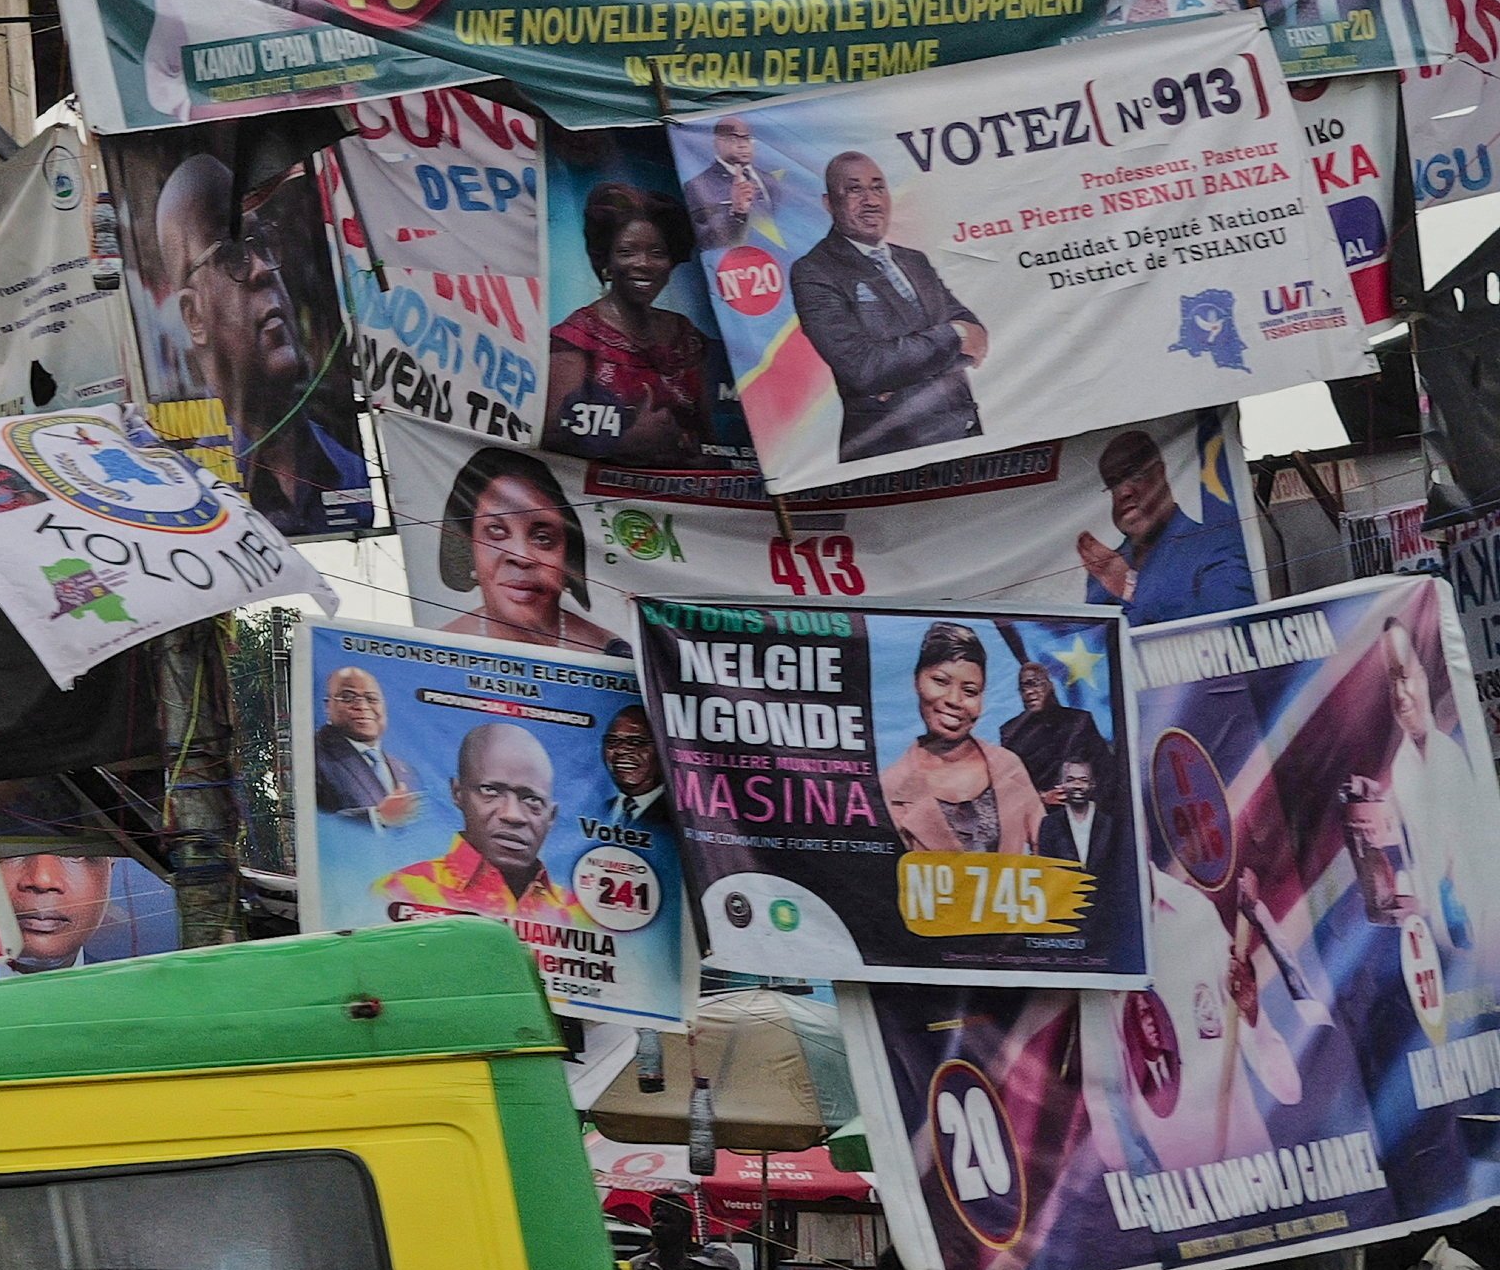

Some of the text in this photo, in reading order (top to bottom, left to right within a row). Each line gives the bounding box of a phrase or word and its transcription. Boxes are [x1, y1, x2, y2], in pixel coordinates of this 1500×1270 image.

[455, 9, 513, 46] UNE
[521, 1, 667, 45] NOUVELLE
[675, 0, 749, 41] PAGE
[764, 40, 939, 86] DE LA FEMME
[897, 100, 1090, 172] VOTEZ
[1082, 141, 1279, 191] Professeur, Pasteur
[952, 162, 1291, 244] Jean Pierre NSENJI BANZA
[1017, 198, 1306, 271] Candidat Député National
[1048, 228, 1288, 291] District de TSHANGU
[570, 403, 622, 437] 374
[34, 511, 214, 591] KOLO
[769, 536, 866, 596] 413
[770, 611, 852, 638] TOUS
[342, 636, 526, 677] SURCONSCRIPTION
[678, 639, 843, 692] NELGIE
[662, 693, 866, 750] NGONDE
[674, 769, 879, 826] MASINA
[580, 818, 652, 849] Votez
[599, 880, 650, 914] 241
[971, 863, 1047, 925] 745
[939, 1089, 1011, 1203] 20
